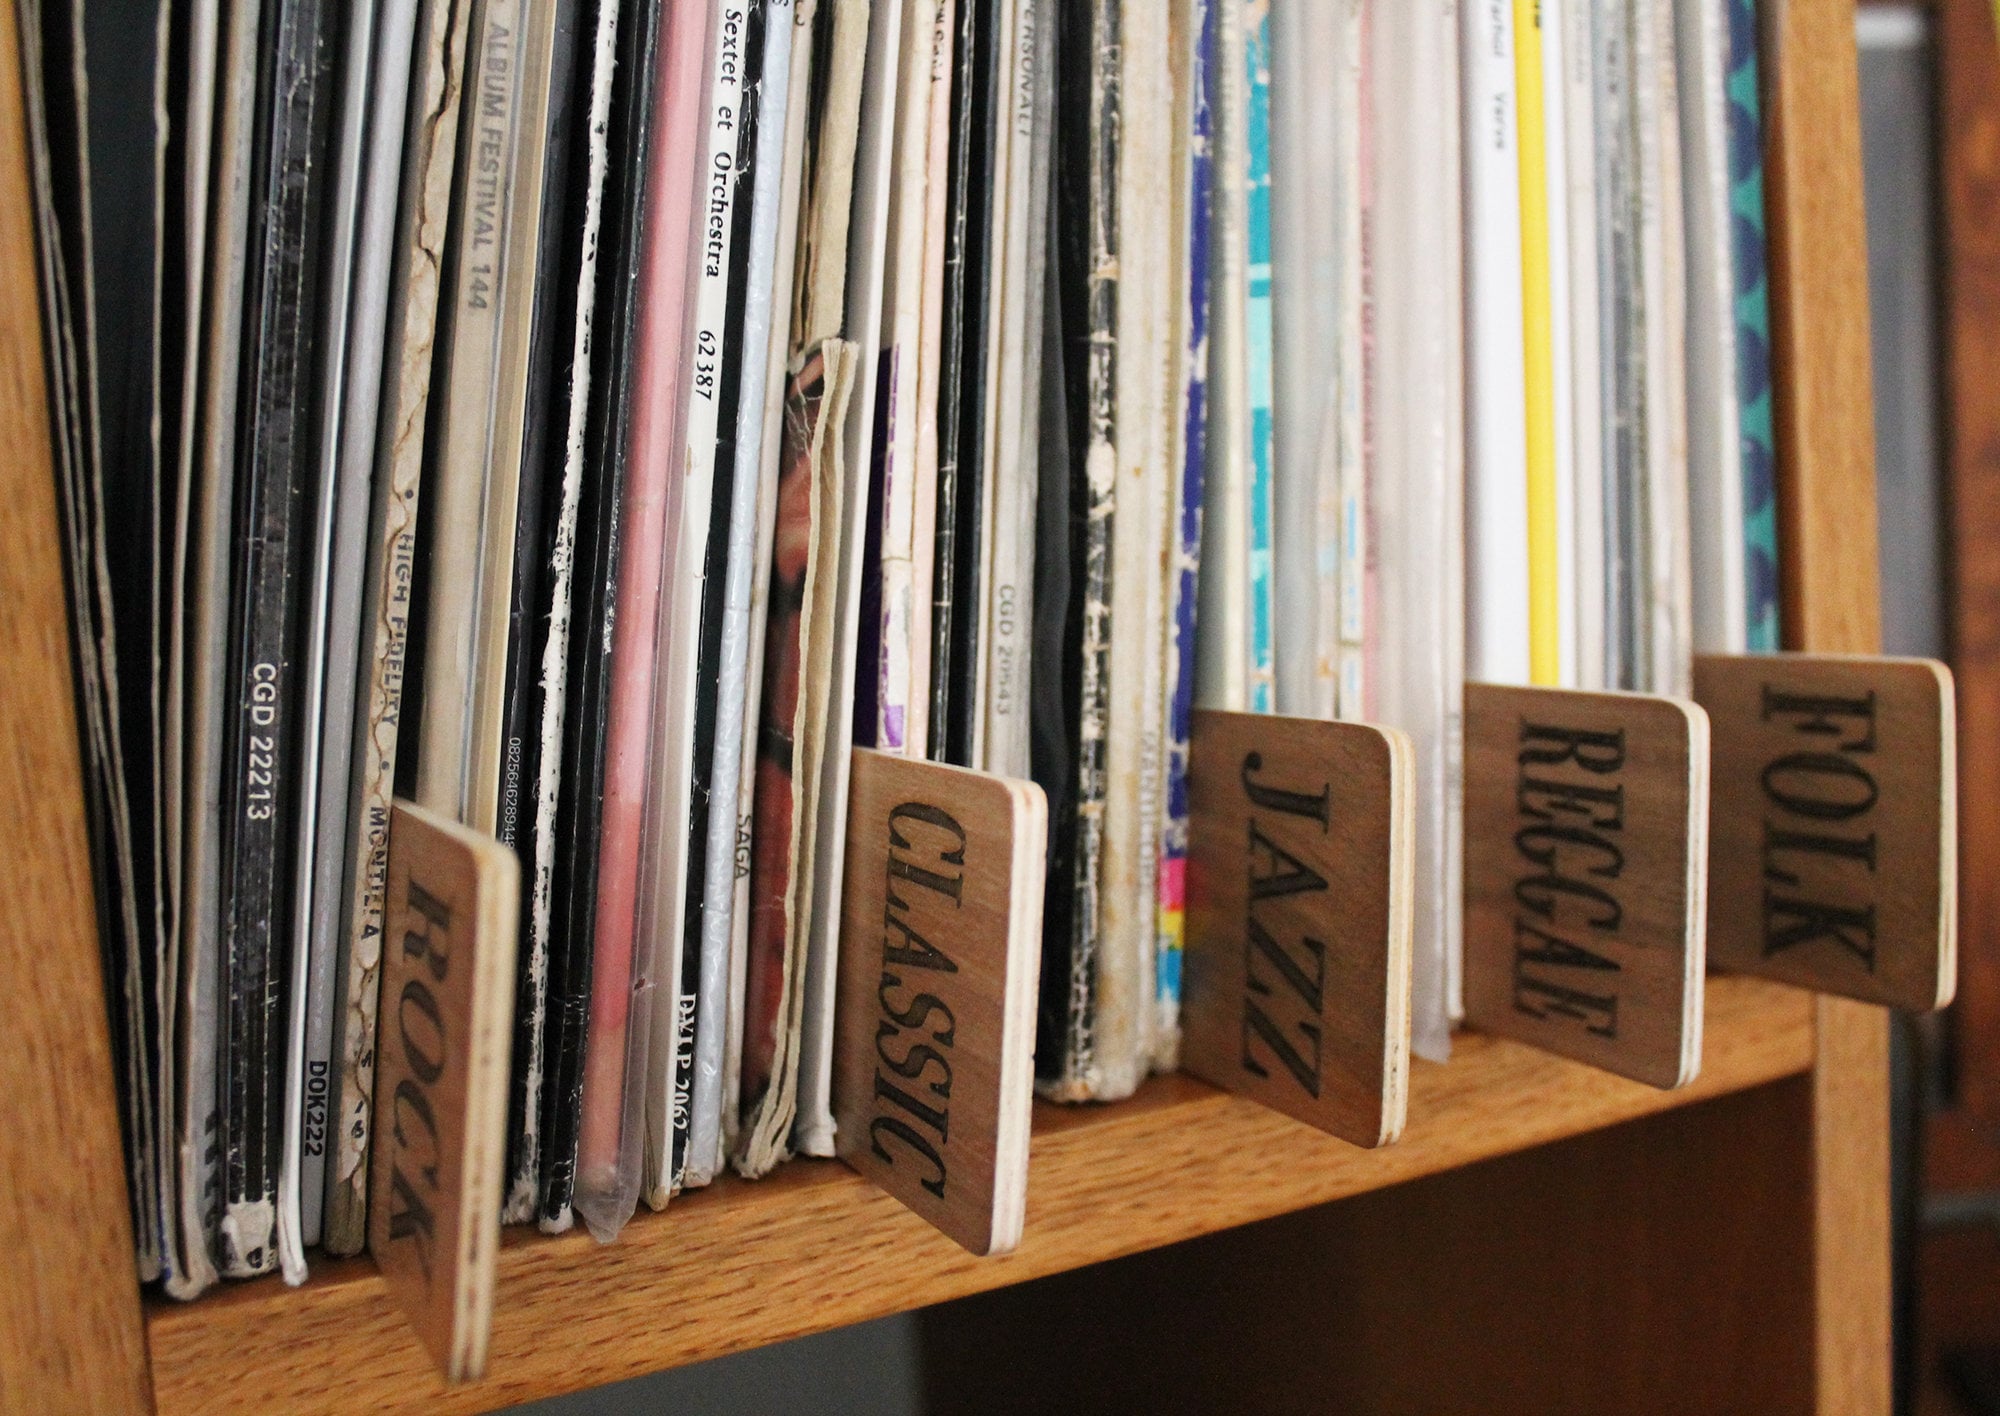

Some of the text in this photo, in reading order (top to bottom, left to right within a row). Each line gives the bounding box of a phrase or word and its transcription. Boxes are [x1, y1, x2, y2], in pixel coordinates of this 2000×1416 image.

[718, 8, 743, 85] Sextet
[467, 22, 512, 311] ALBUM FESTIVAL 144
[715, 105, 735, 131] et
[704, 150, 733, 279] Orchestra
[393, 533, 415, 603] HIGH
[999, 584, 1017, 636] CGD
[382, 616, 408, 729] FIDELITY
[246, 662, 277, 821] CGD 22213
[734, 813, 753, 880] SAGA
[1513, 712, 1626, 1038] REGGAE
[1760, 683, 1879, 974] FOLK
[1239, 750, 1331, 1100] JAZZ
[869, 802, 966, 1200] CLASSIC
[304, 1060, 329, 1157] DOK222
[388, 878, 452, 1280] ROCK
[673, 1078, 691, 1130] 2062
